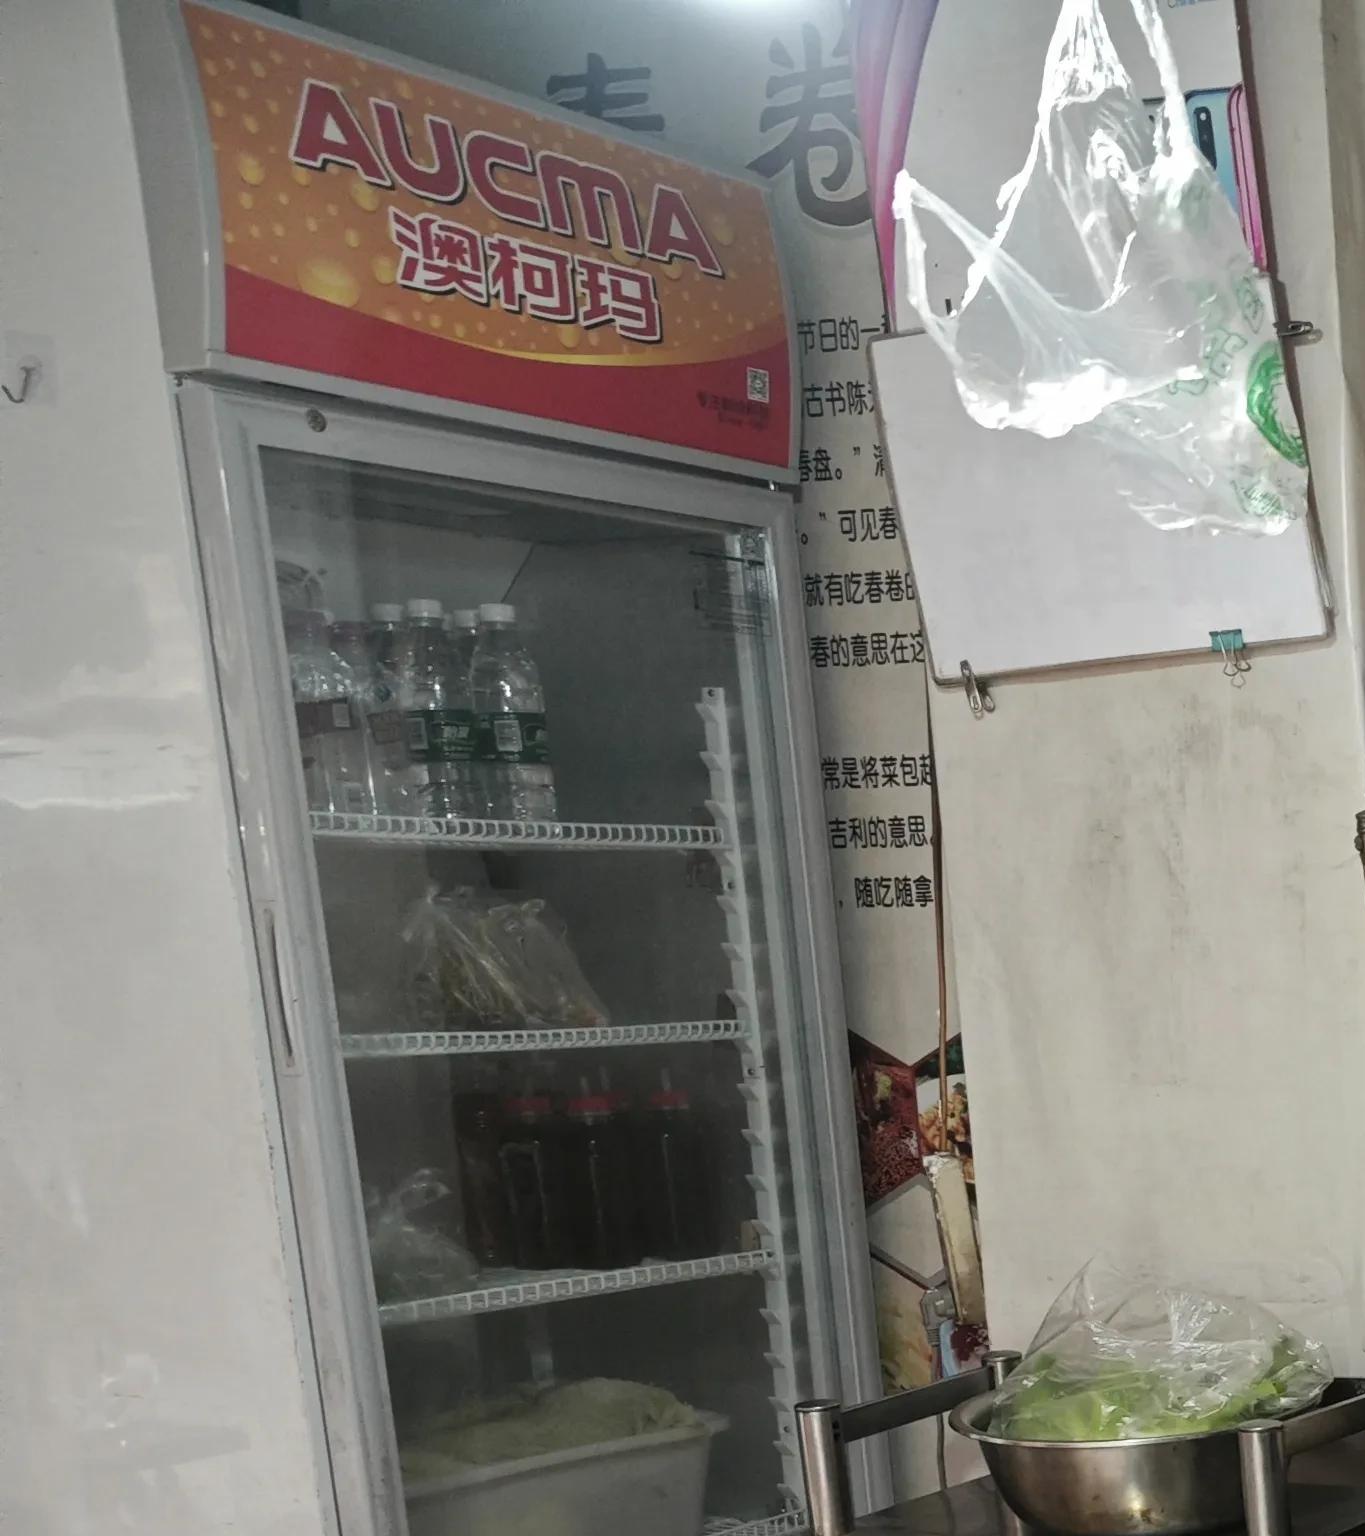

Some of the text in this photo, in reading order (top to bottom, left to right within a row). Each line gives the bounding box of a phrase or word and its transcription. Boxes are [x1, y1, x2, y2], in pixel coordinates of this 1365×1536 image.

[291, 78, 726, 279] AUCMA
[388, 206, 662, 344] 澳柯玛
[804, 380, 875, 418] 古书陈
[810, 631, 926, 668] 春的意思在这
